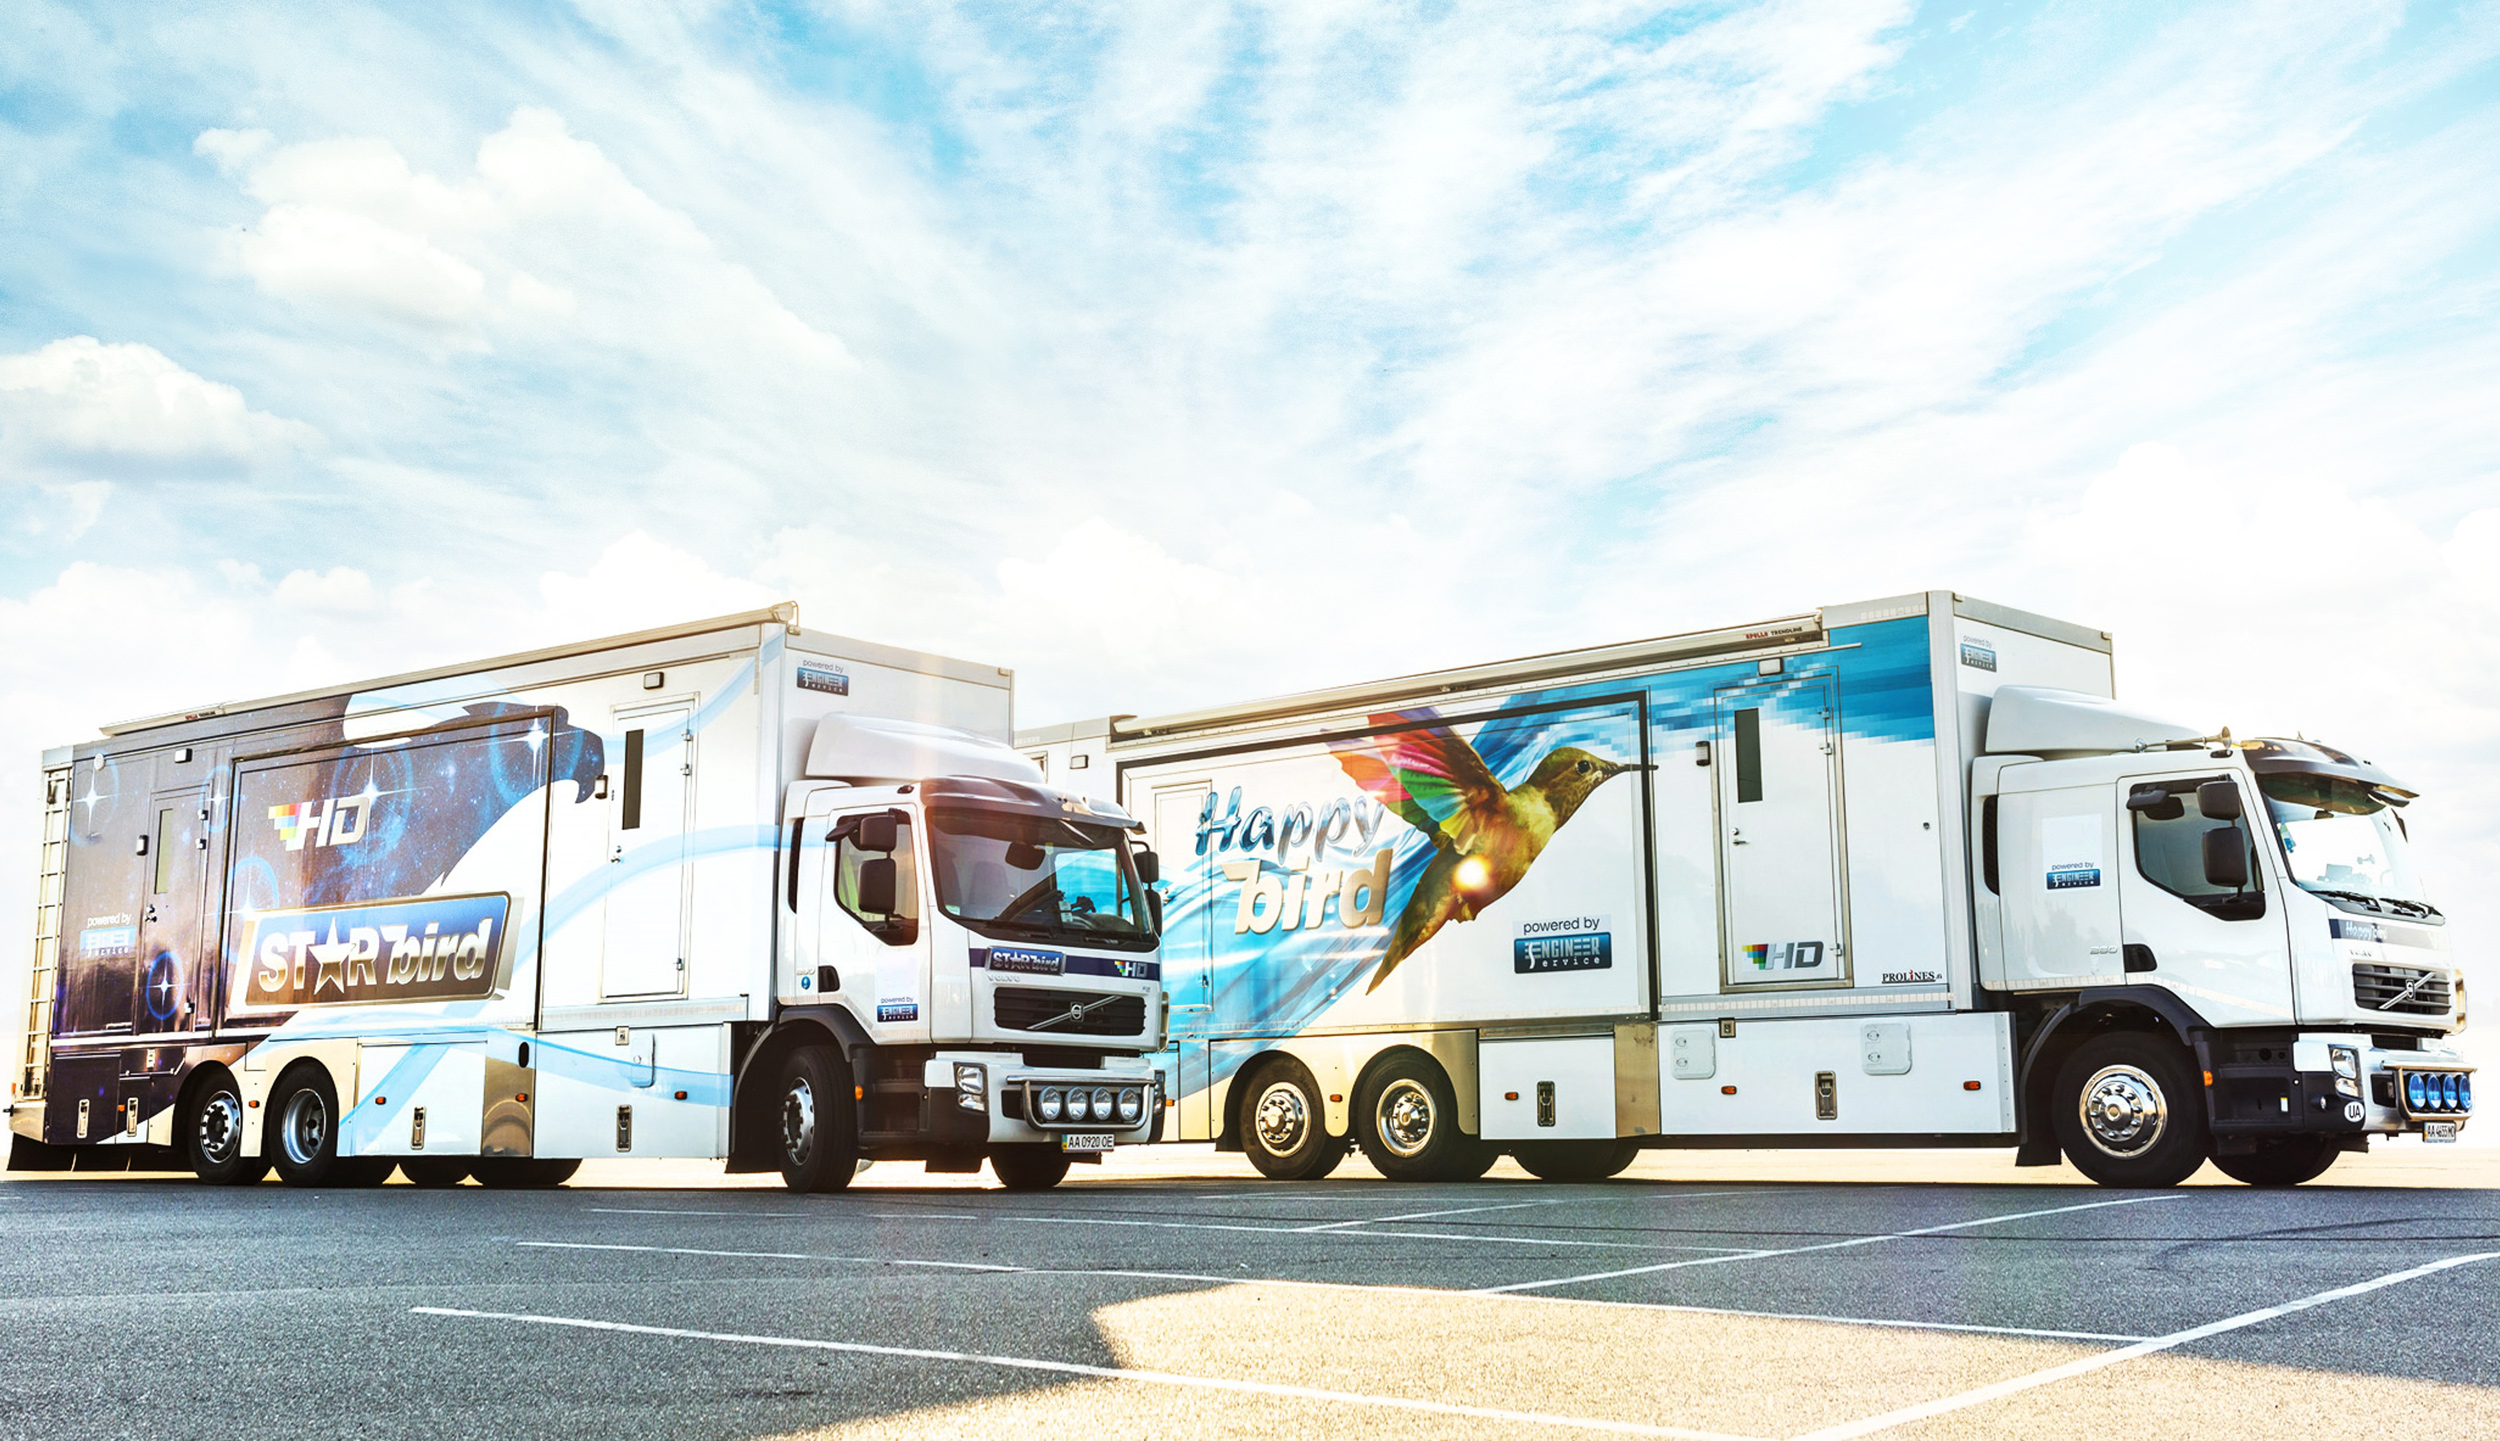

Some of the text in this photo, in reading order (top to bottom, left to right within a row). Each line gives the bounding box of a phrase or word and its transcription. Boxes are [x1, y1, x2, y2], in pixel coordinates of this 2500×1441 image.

[803, 660, 844, 673] powered by
[291, 796, 370, 851] HD
[1195, 786, 1386, 865] Happy
[2052, 862, 2083, 871] powered
[1221, 848, 1394, 935] bird
[87, 912, 132, 928] powered by
[1524, 917, 1600, 935] powered by
[2345, 921, 2372, 941] Happy
[380, 917, 493, 985] bird
[1525, 937, 1600, 959] ENGINEER
[1765, 941, 1824, 970] HD
[1030, 954, 1060, 971] bird
[1124, 961, 1148, 978] HD
[881, 996, 905, 1004] powered
[2348, 1104, 2361, 1119] UA
[2427, 1125, 2436, 1138] AA
[1068, 1136, 1113, 1148] AA 0920 OE
